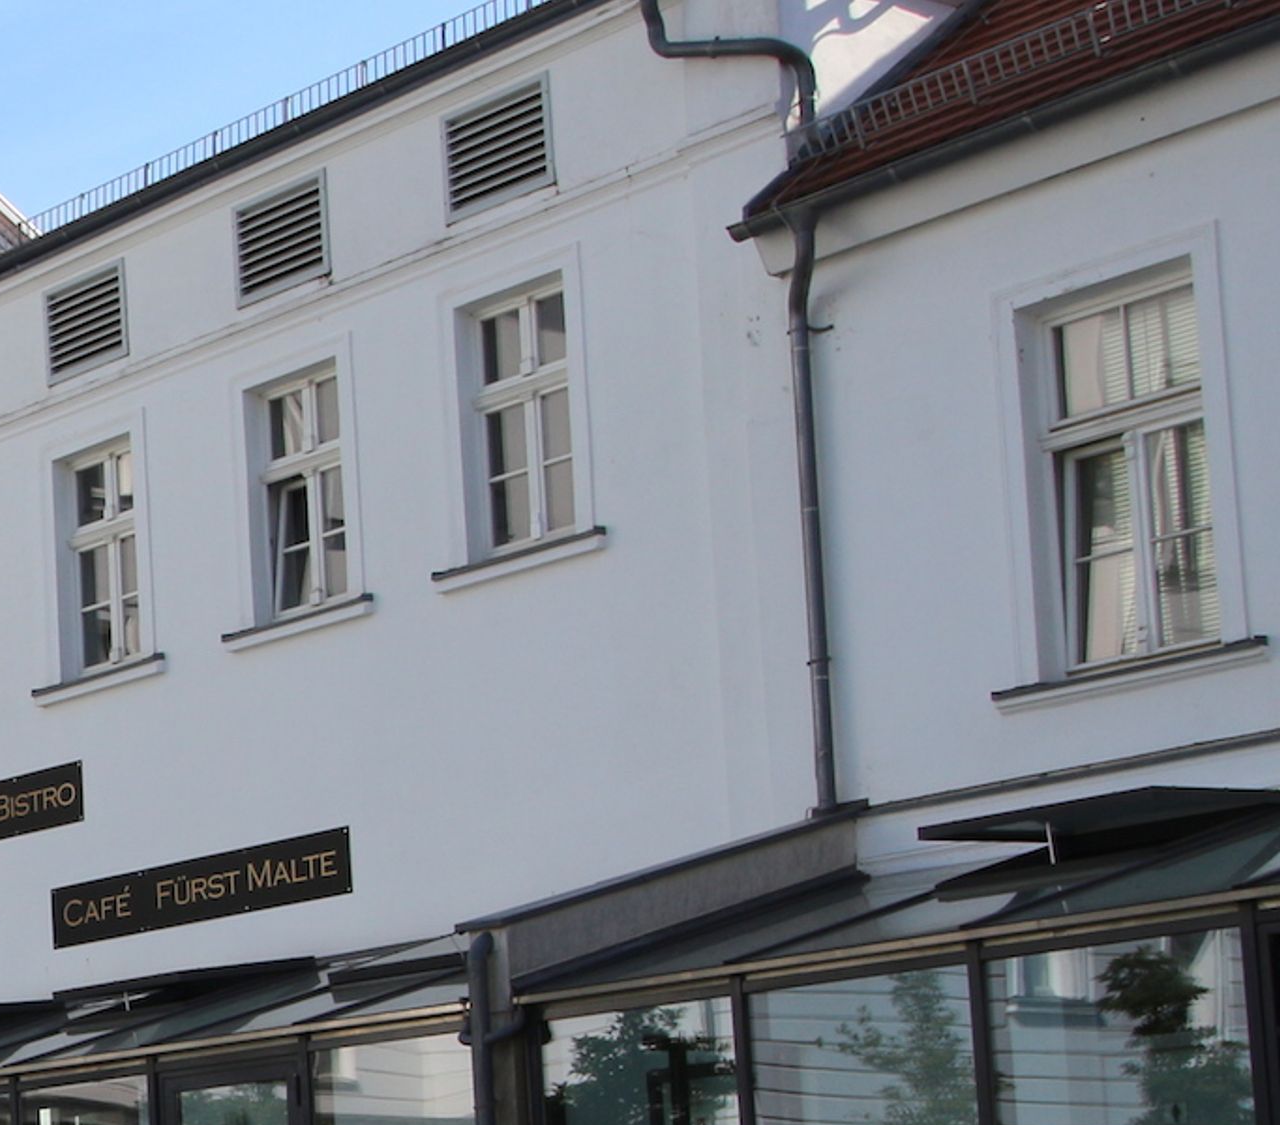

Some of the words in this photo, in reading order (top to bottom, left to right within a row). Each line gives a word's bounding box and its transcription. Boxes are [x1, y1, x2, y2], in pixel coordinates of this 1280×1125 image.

[63, 886, 131, 927] CAFÉ
[156, 870, 240, 909] FÜRST
[247, 849, 337, 892] MALTE
